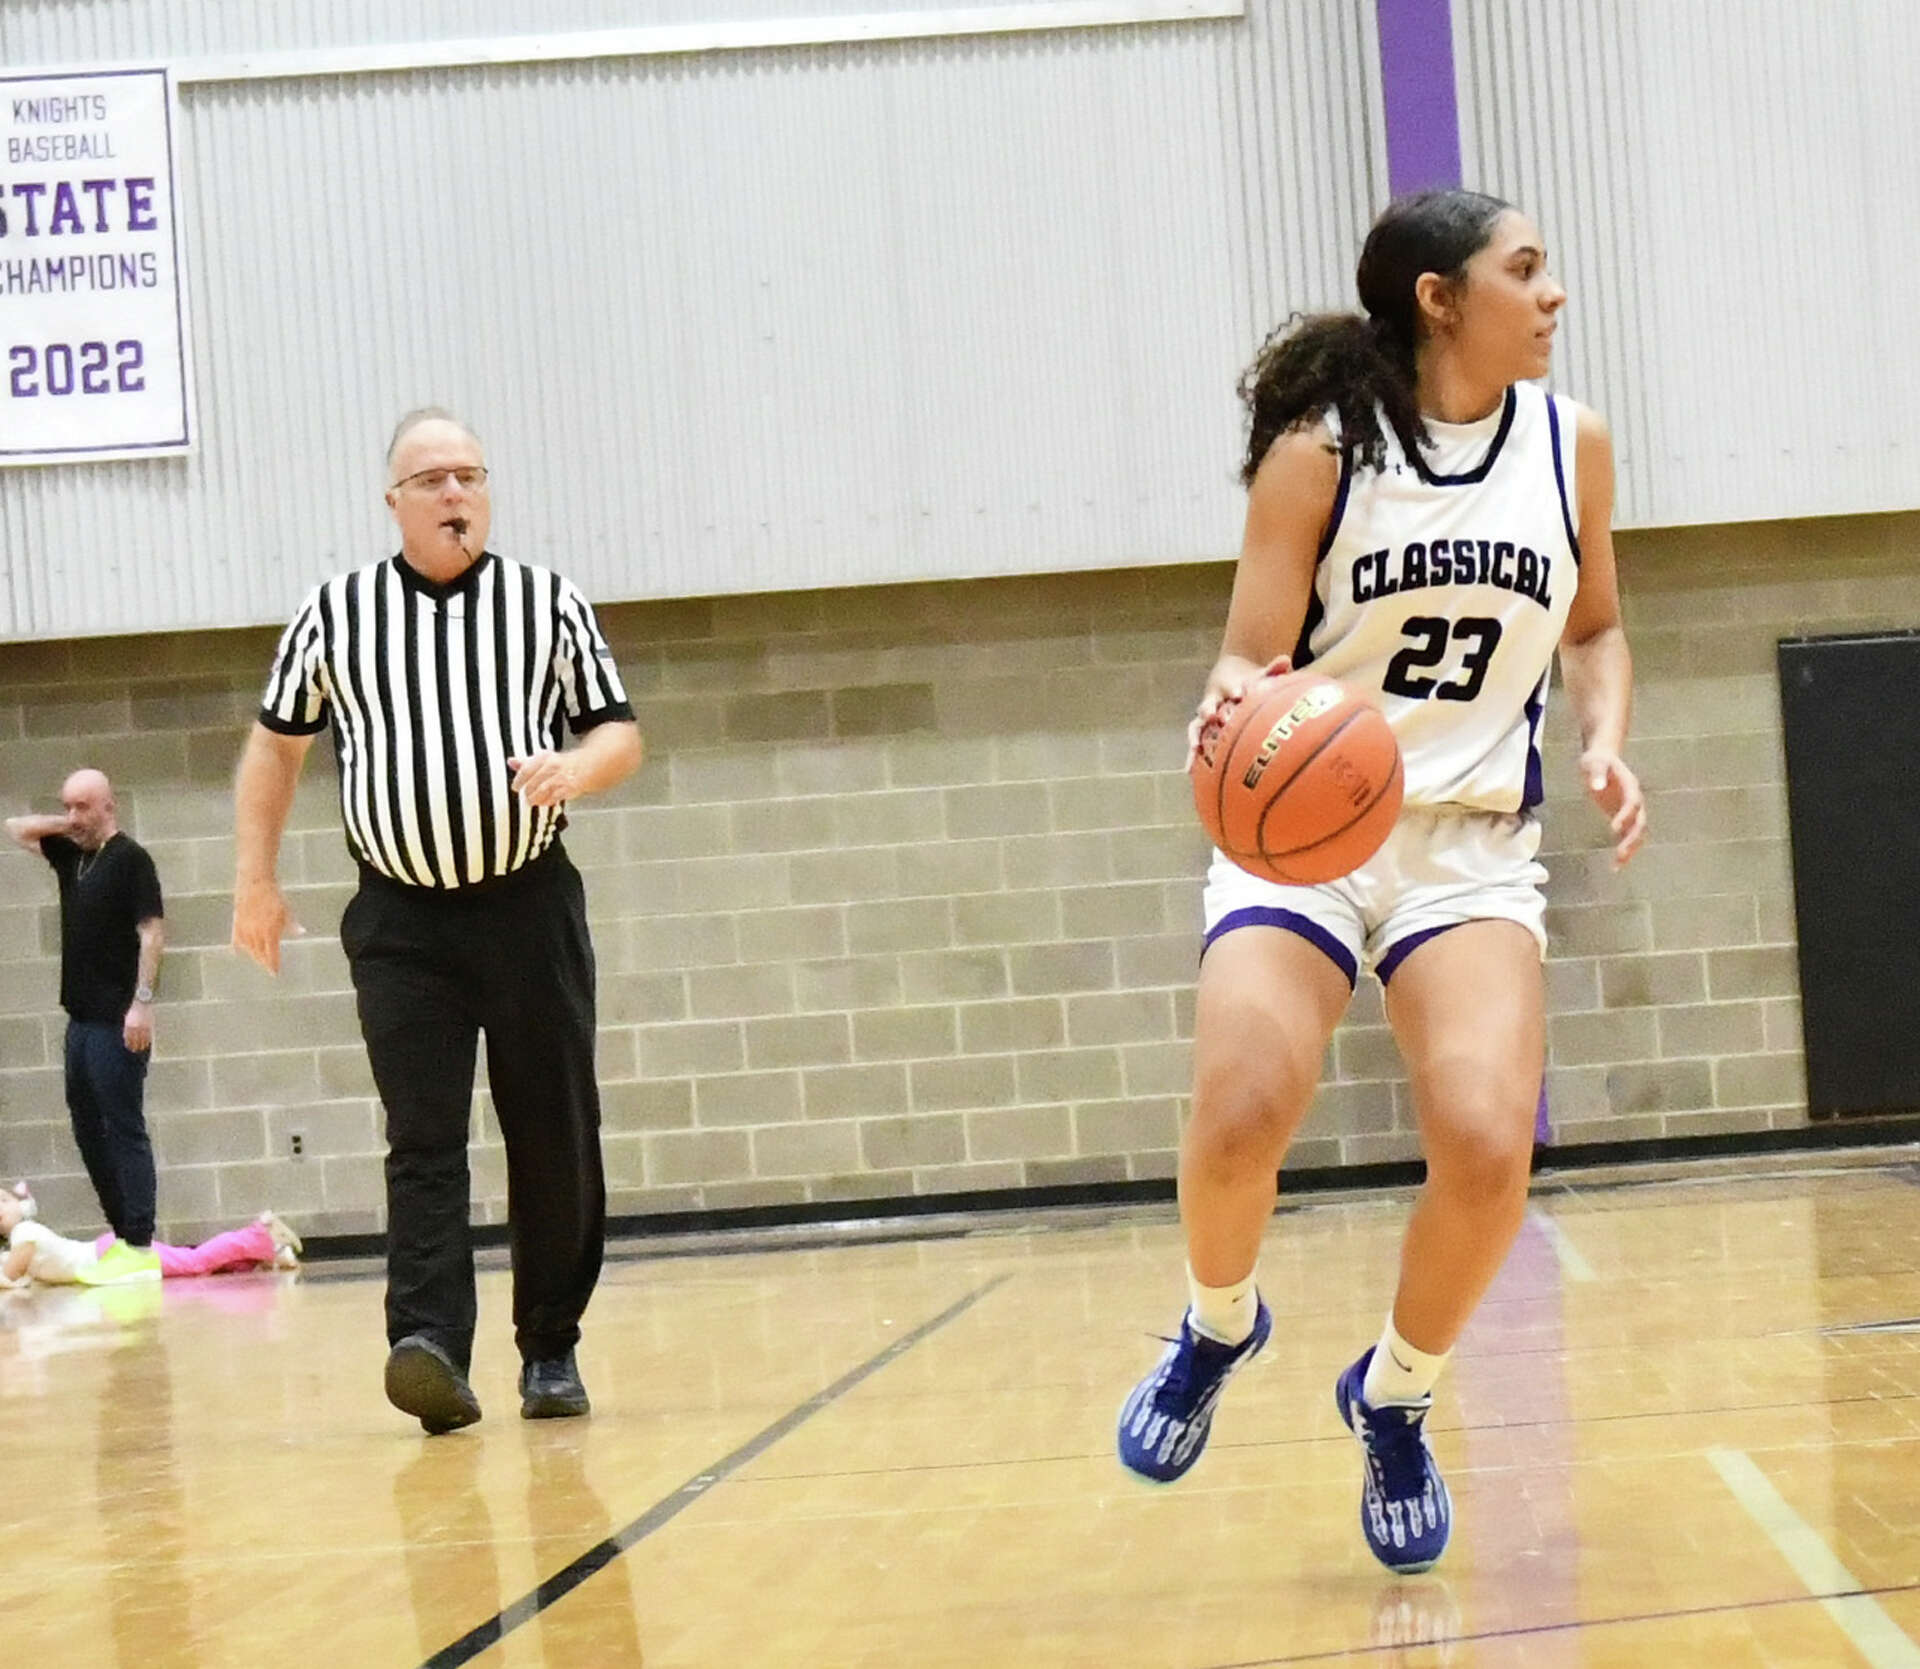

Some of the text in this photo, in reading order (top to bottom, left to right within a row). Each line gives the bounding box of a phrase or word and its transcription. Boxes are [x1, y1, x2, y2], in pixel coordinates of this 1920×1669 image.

[13, 95, 107, 124] KNIGHTS
[8, 133, 117, 163] BASEBALL
[9, 340, 146, 398] 2022
[1352, 539, 1552, 611] CLASSICAL
[1382, 616, 1503, 702] 23
